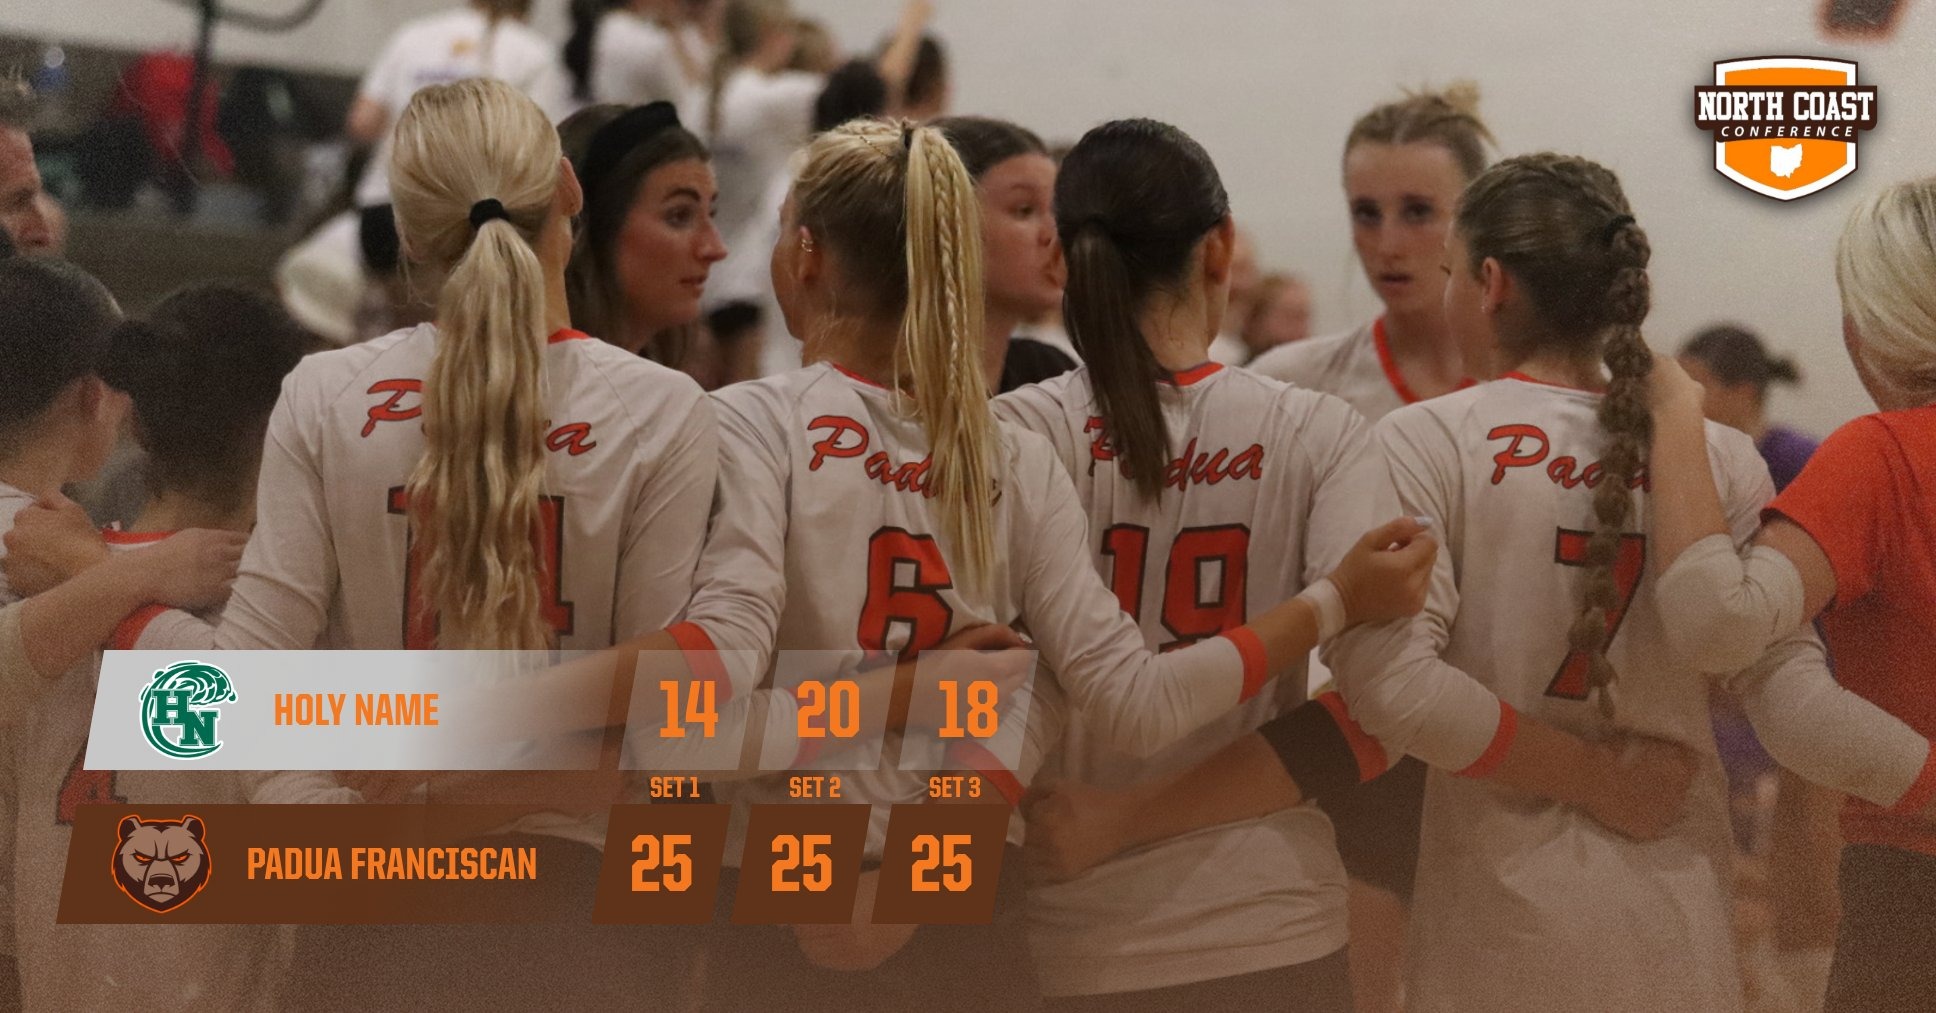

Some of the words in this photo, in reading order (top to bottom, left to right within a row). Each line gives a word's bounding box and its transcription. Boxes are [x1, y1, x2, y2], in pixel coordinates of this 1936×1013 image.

[857, 525, 953, 664] 6
[1101, 522, 1250, 655] 19
[1543, 526, 1647, 701] 7
